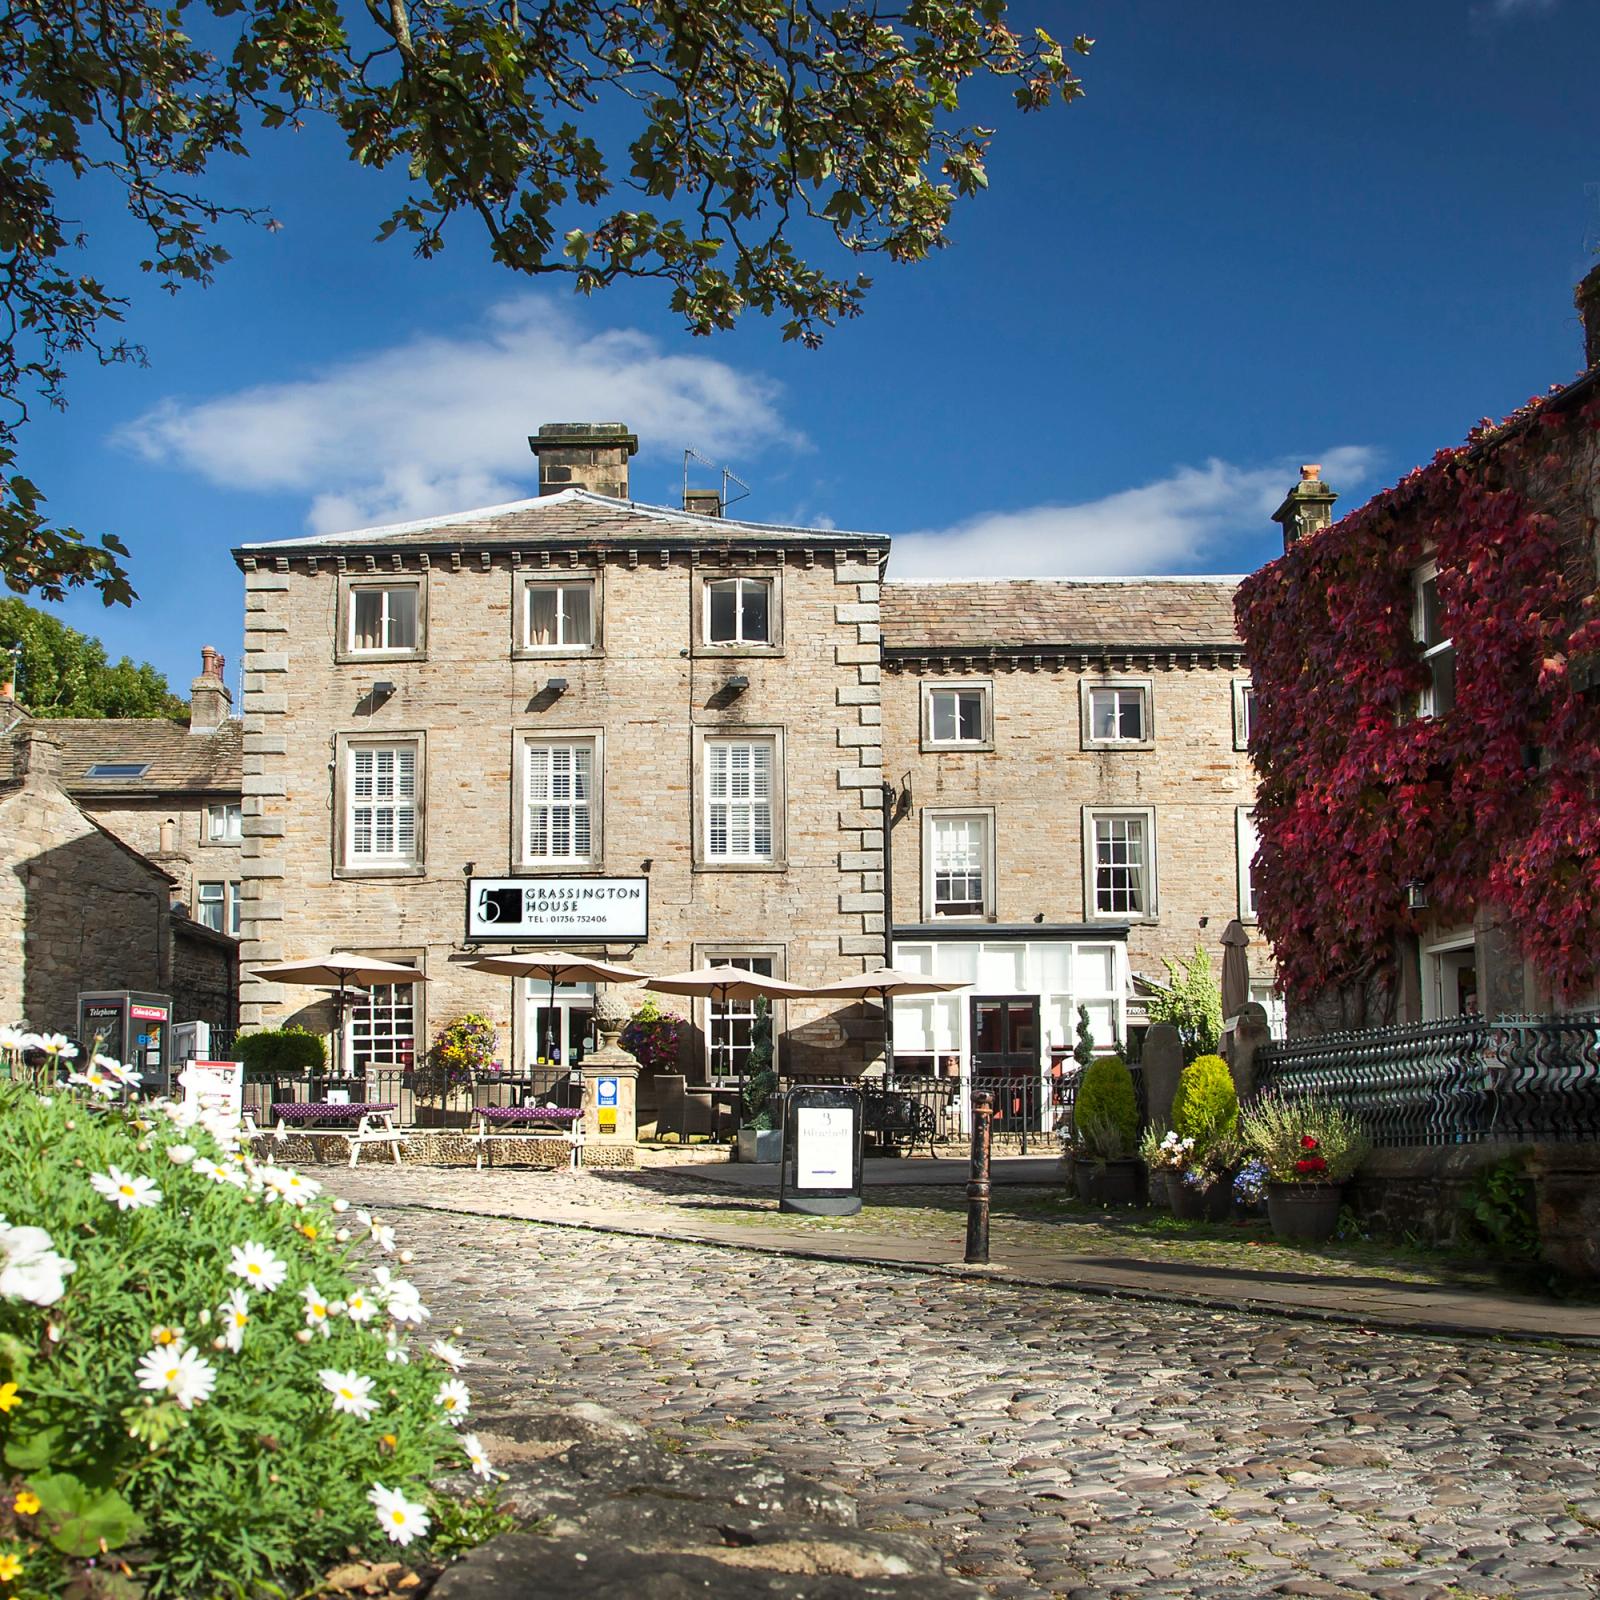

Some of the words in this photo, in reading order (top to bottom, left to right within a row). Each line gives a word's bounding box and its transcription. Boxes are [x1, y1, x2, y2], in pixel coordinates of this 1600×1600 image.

[525, 888, 640, 899] GRASSINGTON
[526, 901, 578, 912] HOUSE
[550, 915, 575, 923] 01756
[577, 915, 607, 923] 752406
[90, 1008, 118, 1017] Telephone
